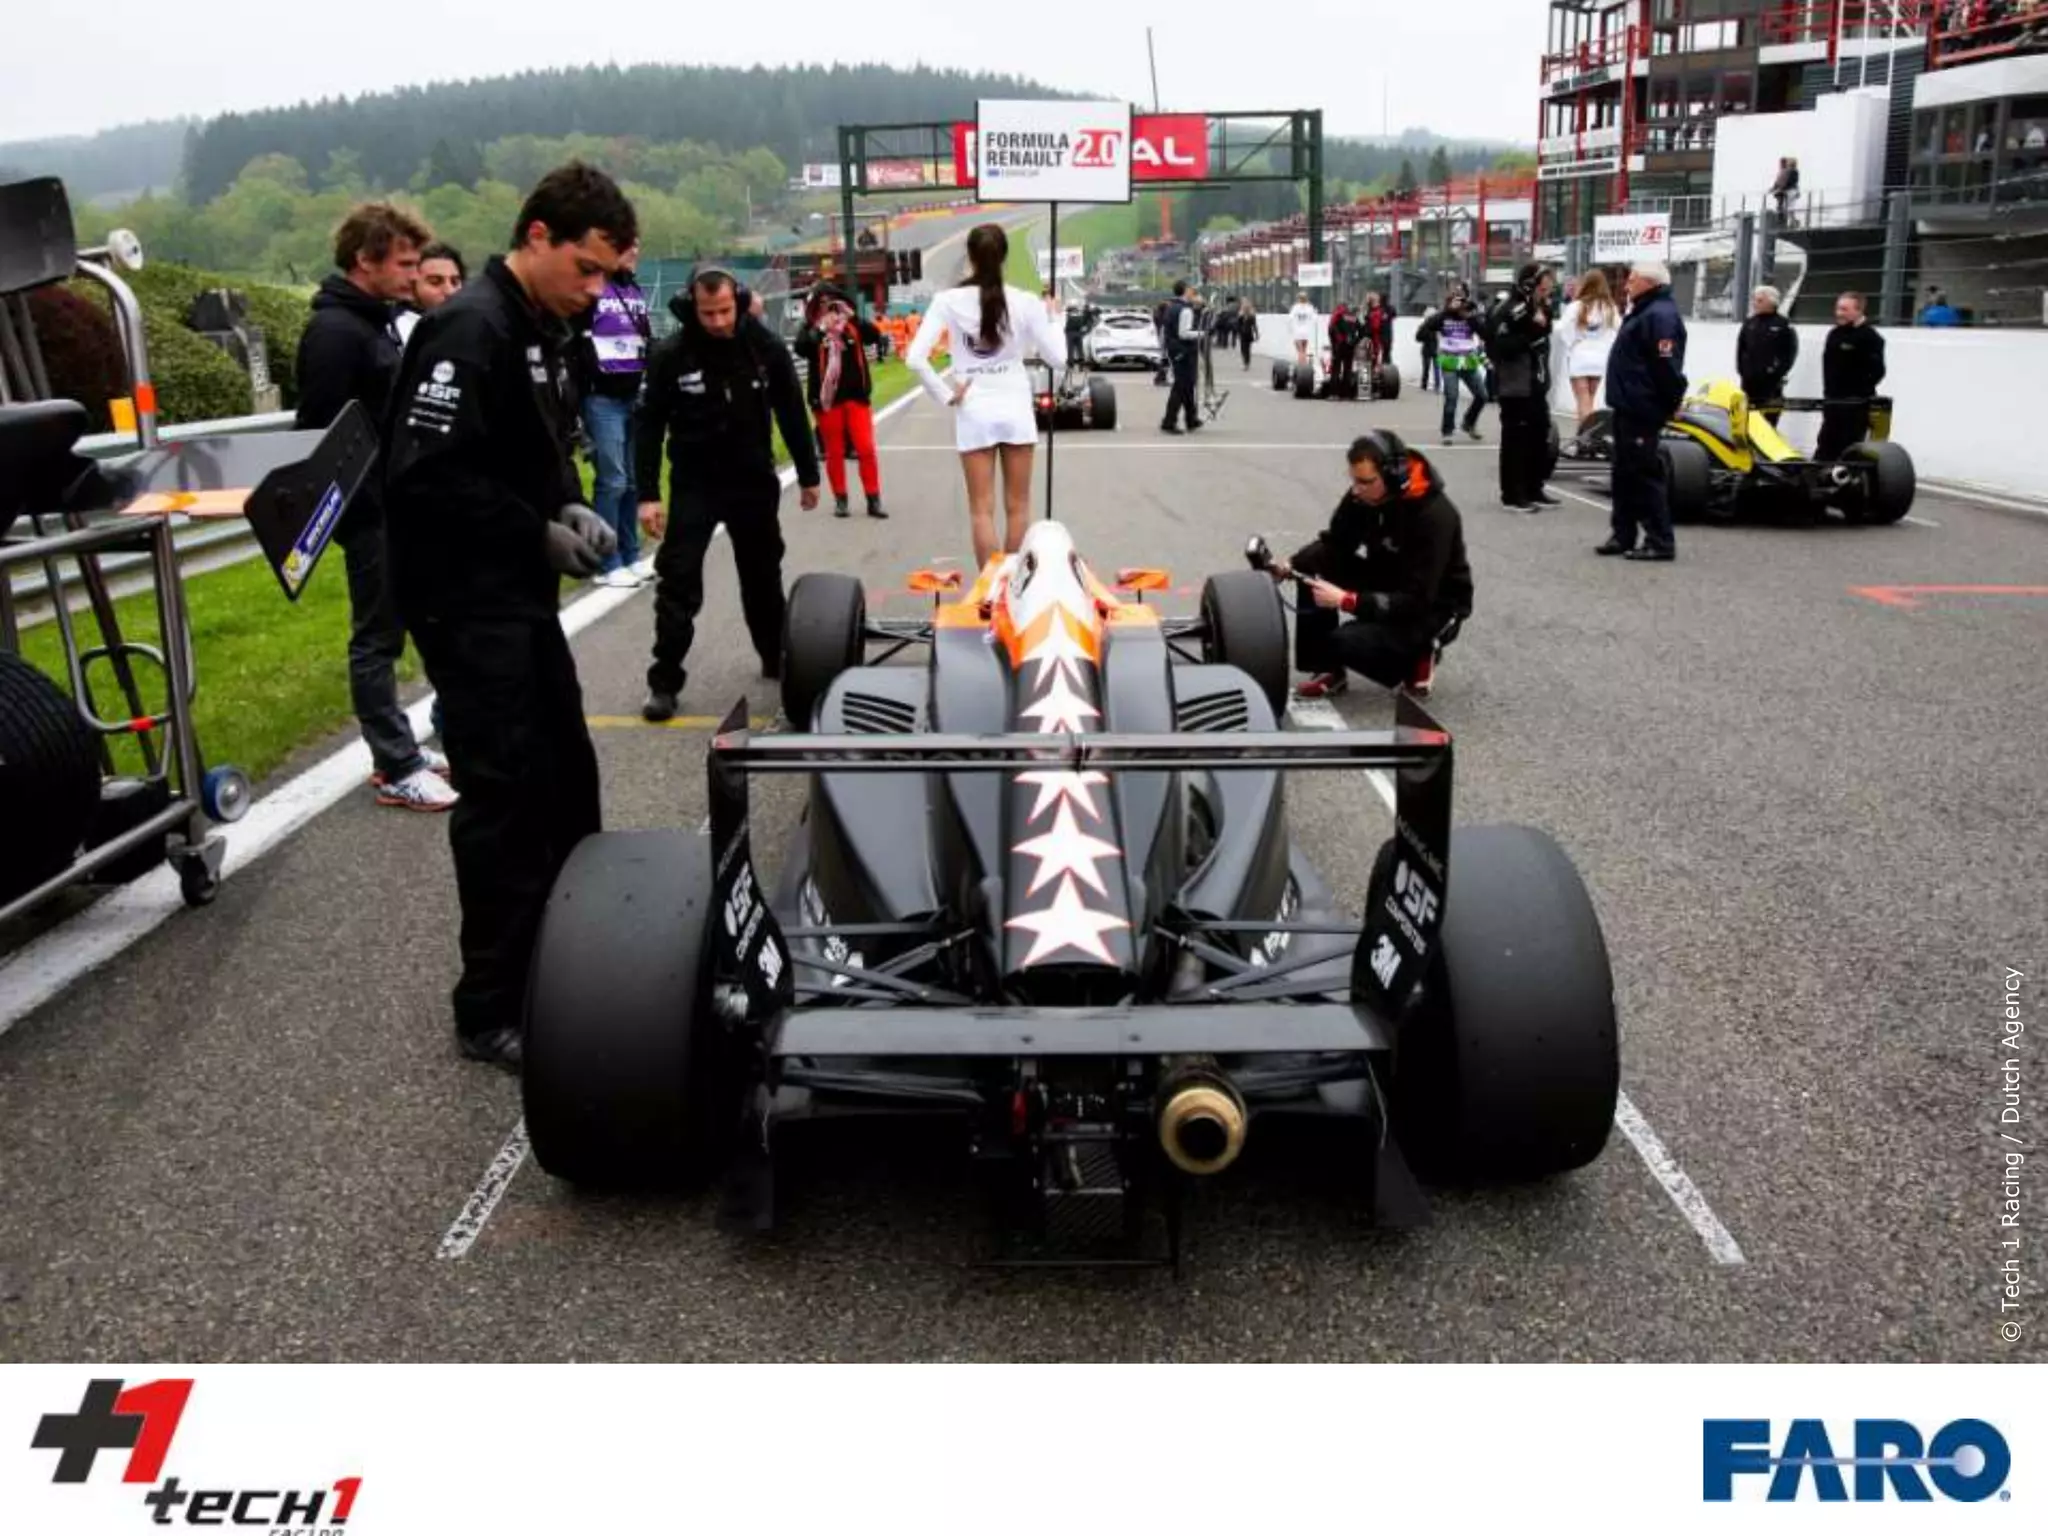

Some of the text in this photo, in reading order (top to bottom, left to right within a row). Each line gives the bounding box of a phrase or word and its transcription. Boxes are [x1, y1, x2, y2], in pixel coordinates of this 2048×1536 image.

[986, 132, 1069, 148] FORMULA
[986, 130, 1121, 167] RENAULT 2.0
